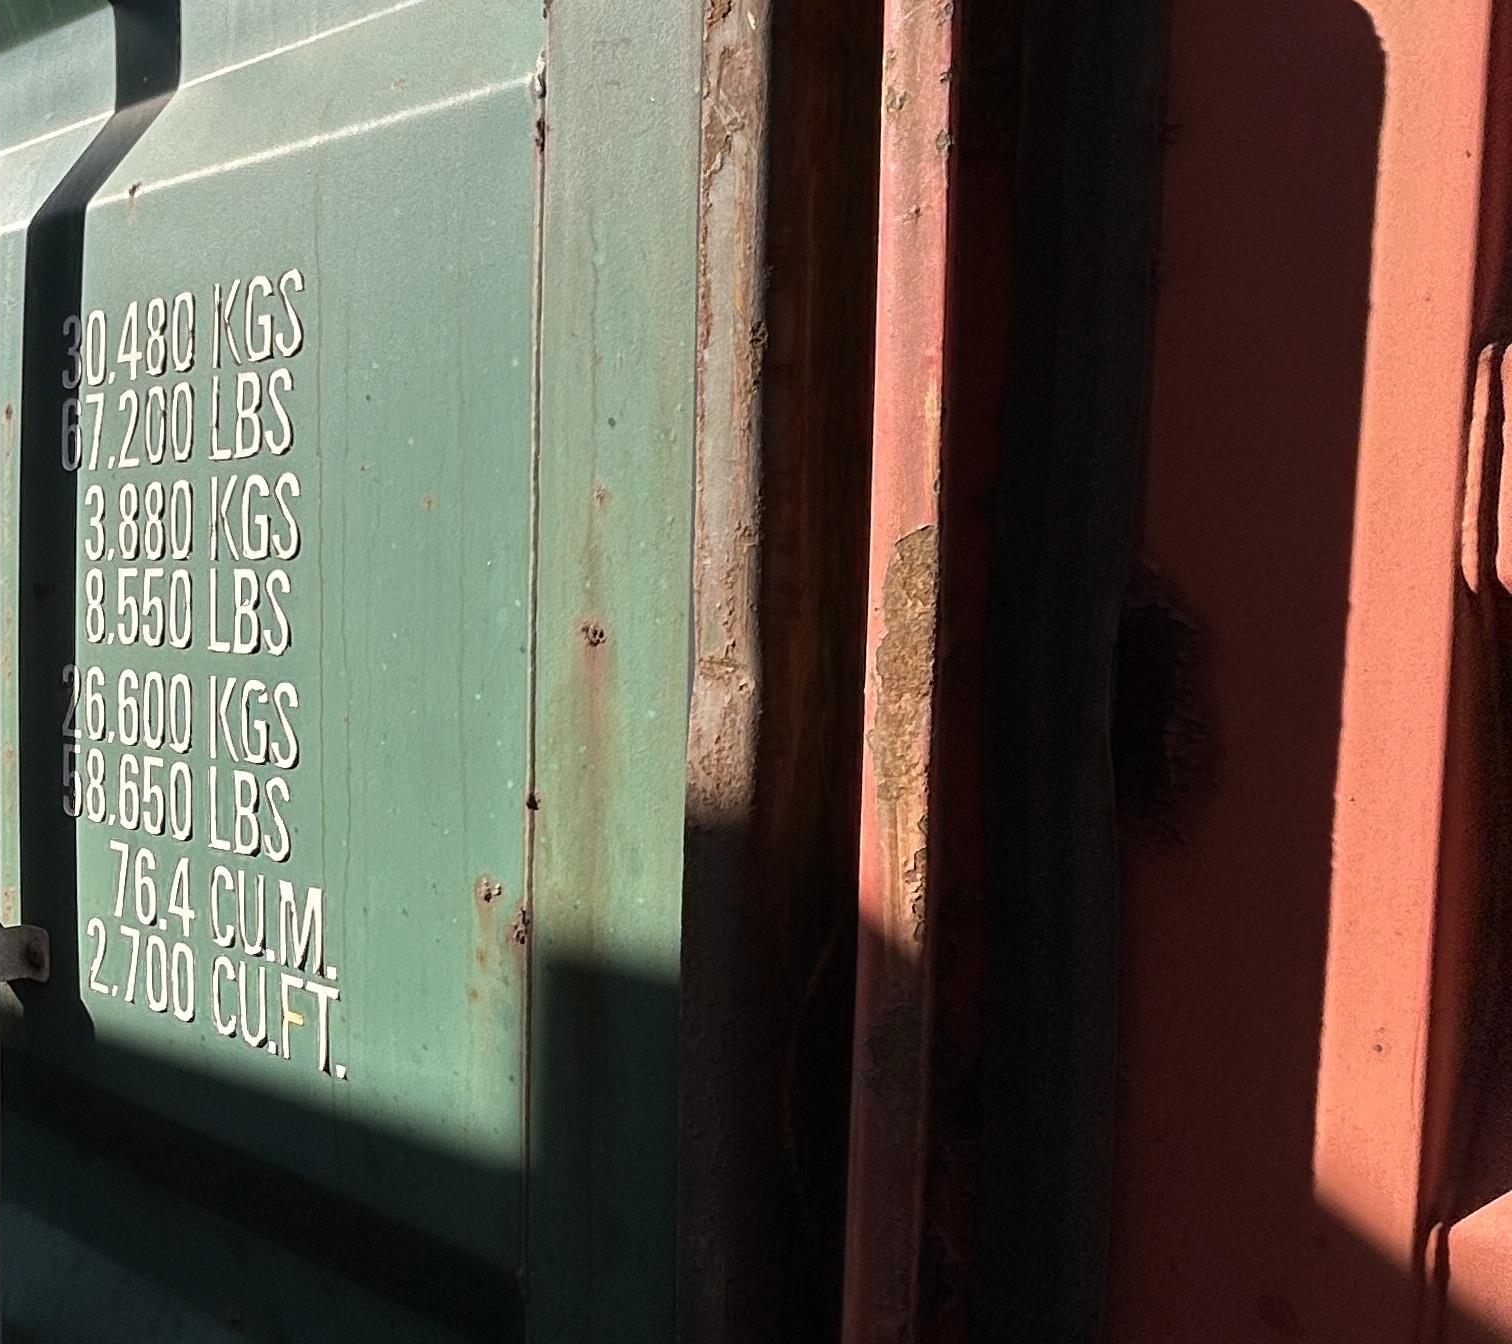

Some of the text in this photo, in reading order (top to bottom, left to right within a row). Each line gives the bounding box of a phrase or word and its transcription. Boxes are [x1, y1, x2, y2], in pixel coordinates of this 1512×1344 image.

[61, 267, 305, 390] 30,480 KGS
[61, 367, 294, 472] 67,200 LBS
[84, 471, 302, 562] 3,880 KGS
[85, 567, 292, 657] 8,550 LBS
[61, 663, 299, 770] 26,600 KGS
[62, 742, 292, 863] 58,650 LBS
[109, 839, 338, 982] 76.4 CU.M.
[212, 954, 348, 1081] CU.FT.
